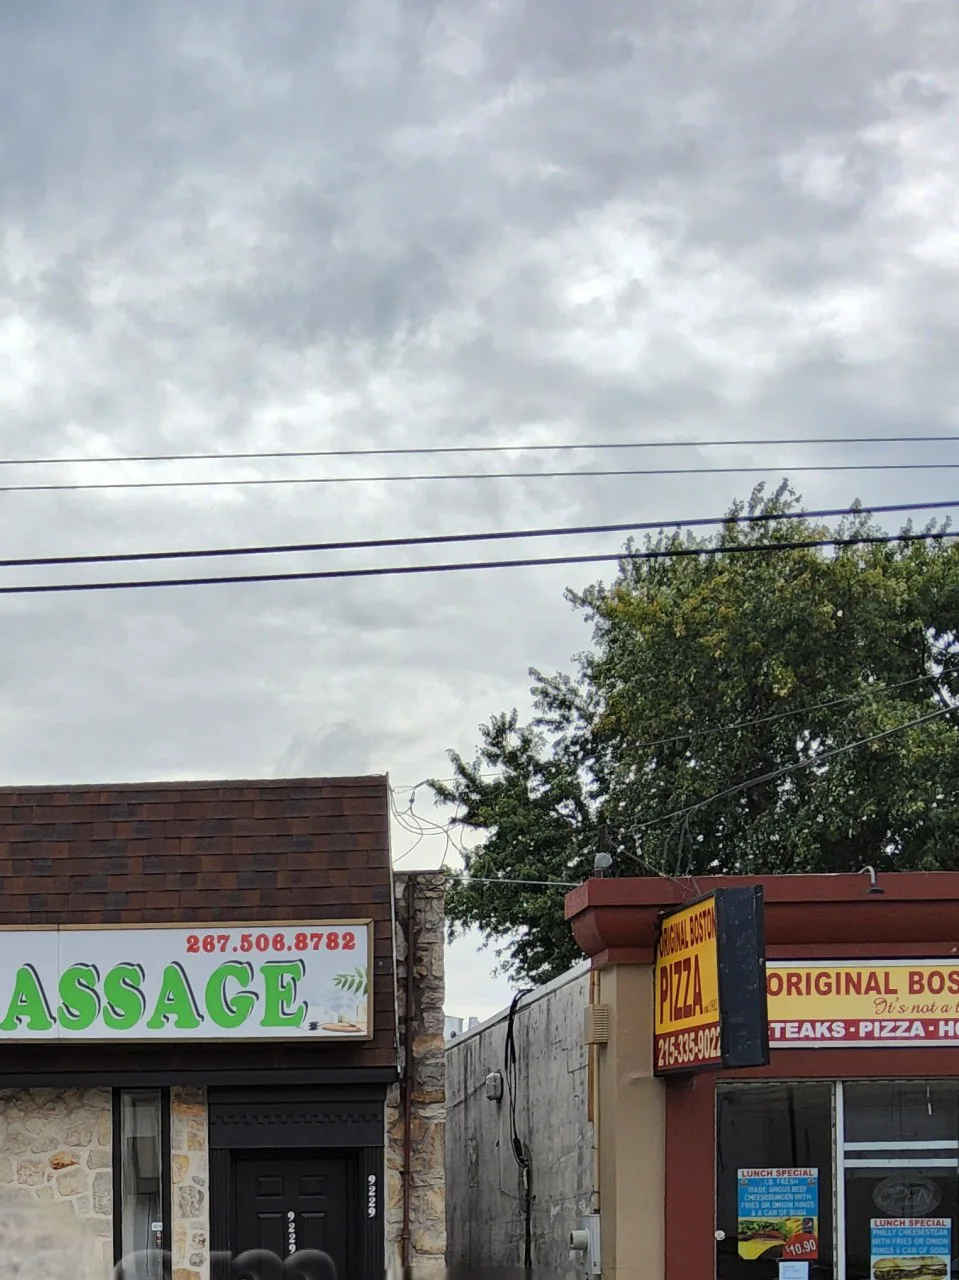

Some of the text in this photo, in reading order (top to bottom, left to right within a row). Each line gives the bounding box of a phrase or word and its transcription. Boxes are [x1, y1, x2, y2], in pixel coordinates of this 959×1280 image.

[186, 931, 356, 954] 267.506.8782
[658, 907, 716, 958] ORIGINAL BOSTON
[659, 953, 703, 1025] PIZZA
[766, 971, 899, 997] ORIGINAL
[911, 1001, 938, 1014] not
[940, 1004, 952, 1014] a
[768, 1022, 846, 1038] TEAKS
[858, 1021, 925, 1038] PIZZA
[657, 1026, 721, 1067] 215-335-9022
[741, 1169, 815, 1177] LUNCH SPECIAL
[367, 1174, 377, 1219] 9229
[287, 1210, 297, 1255] 9229
[874, 1219, 947, 1227] LUNCH SPECIAL
[785, 1239, 817, 1256] $10.90
